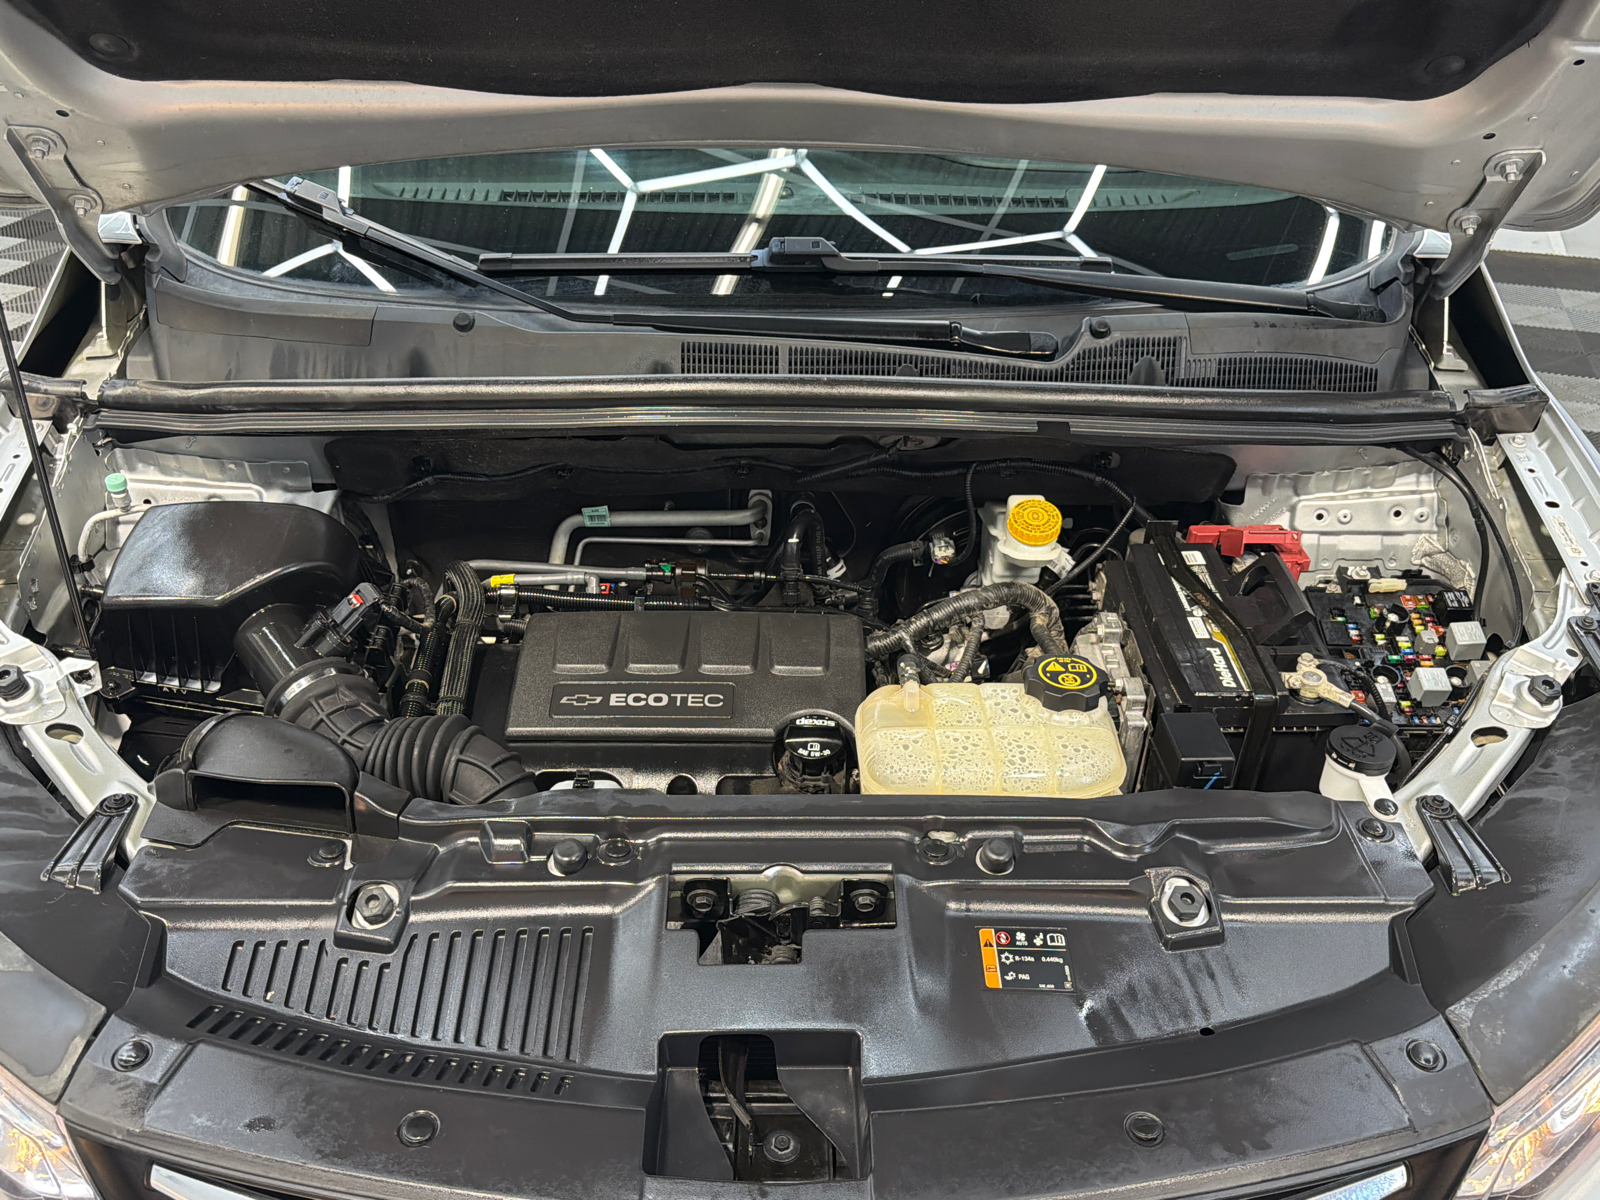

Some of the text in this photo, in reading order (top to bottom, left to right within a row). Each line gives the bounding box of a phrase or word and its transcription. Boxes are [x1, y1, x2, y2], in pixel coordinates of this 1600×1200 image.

[1206, 647, 1237, 688] DieHard
[609, 693, 724, 707] ECOTEC
[796, 717, 835, 727] dexos
[798, 748, 831, 757] SAE 5W-30
